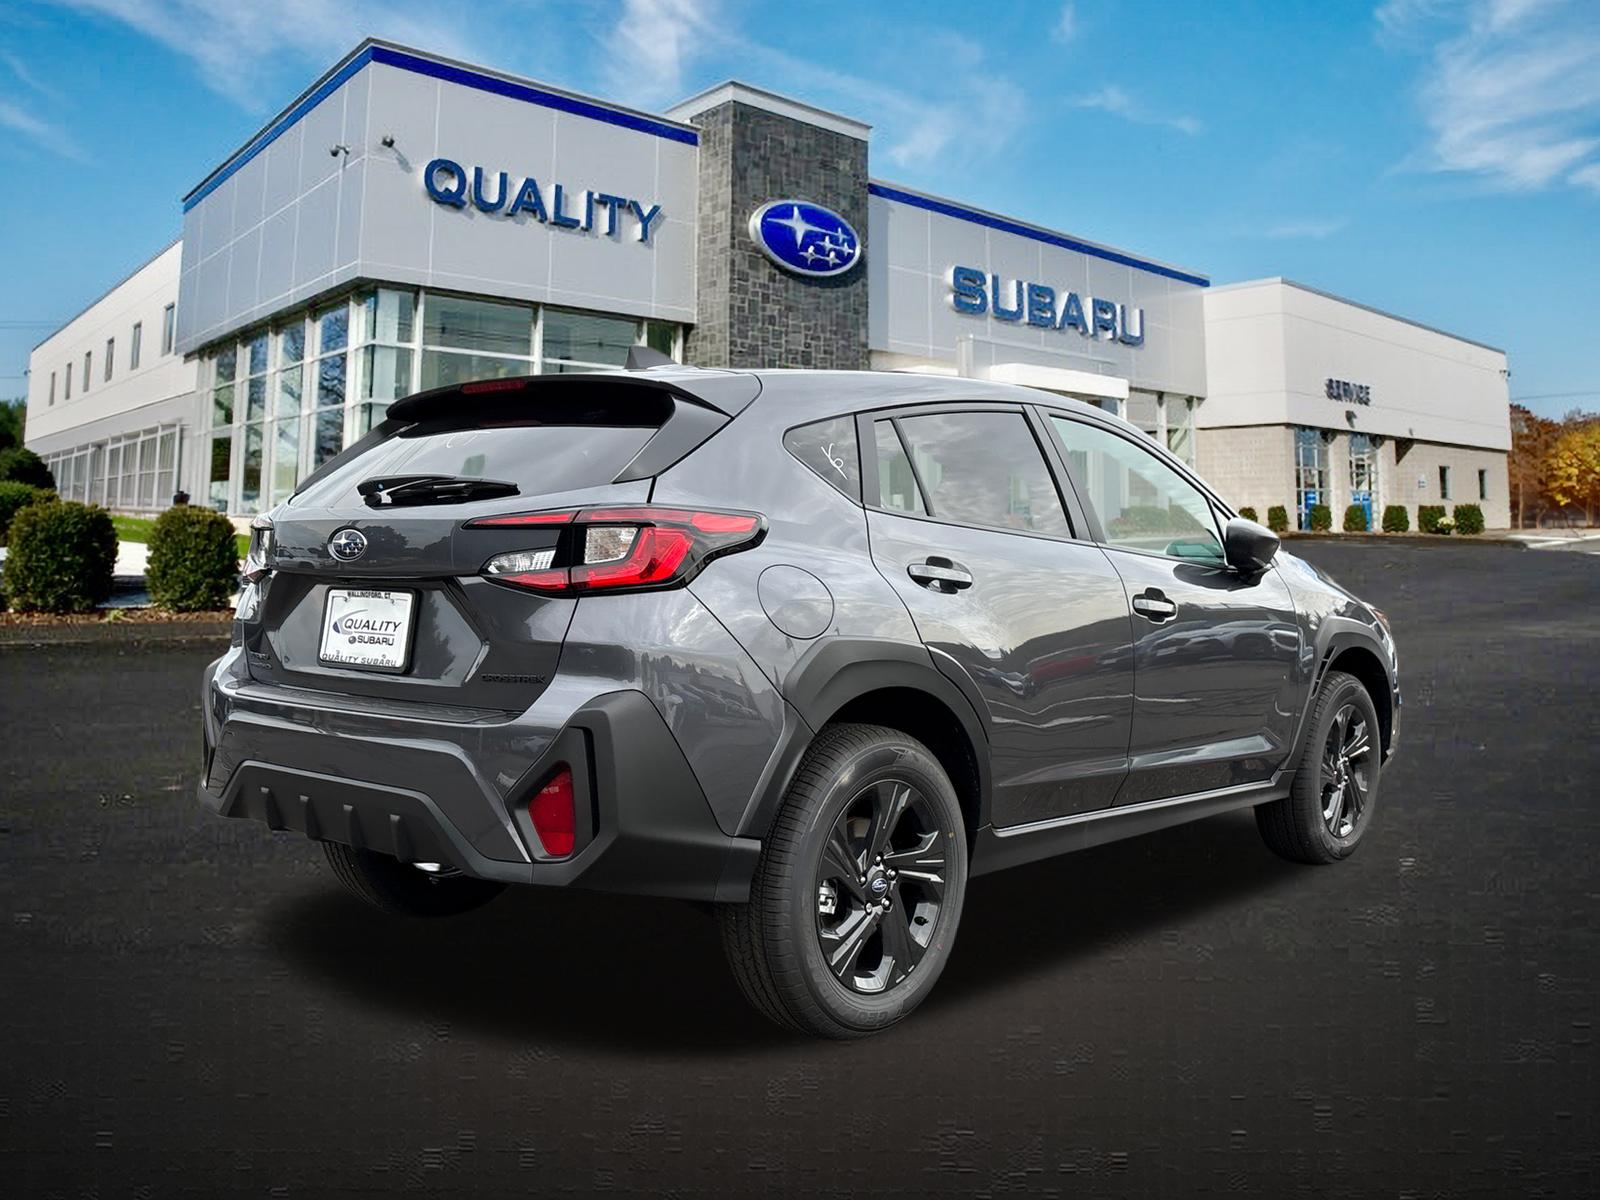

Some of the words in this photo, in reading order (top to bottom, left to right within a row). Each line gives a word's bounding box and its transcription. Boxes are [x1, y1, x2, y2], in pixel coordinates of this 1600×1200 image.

[424, 158, 662, 242] QUALITY
[949, 265, 1145, 347] SUBARU
[344, 618, 402, 632] QUALITY
[357, 635, 395, 646] SUBARU
[322, 653, 359, 663] QUALITY
[360, 657, 397, 666] SUBARU
